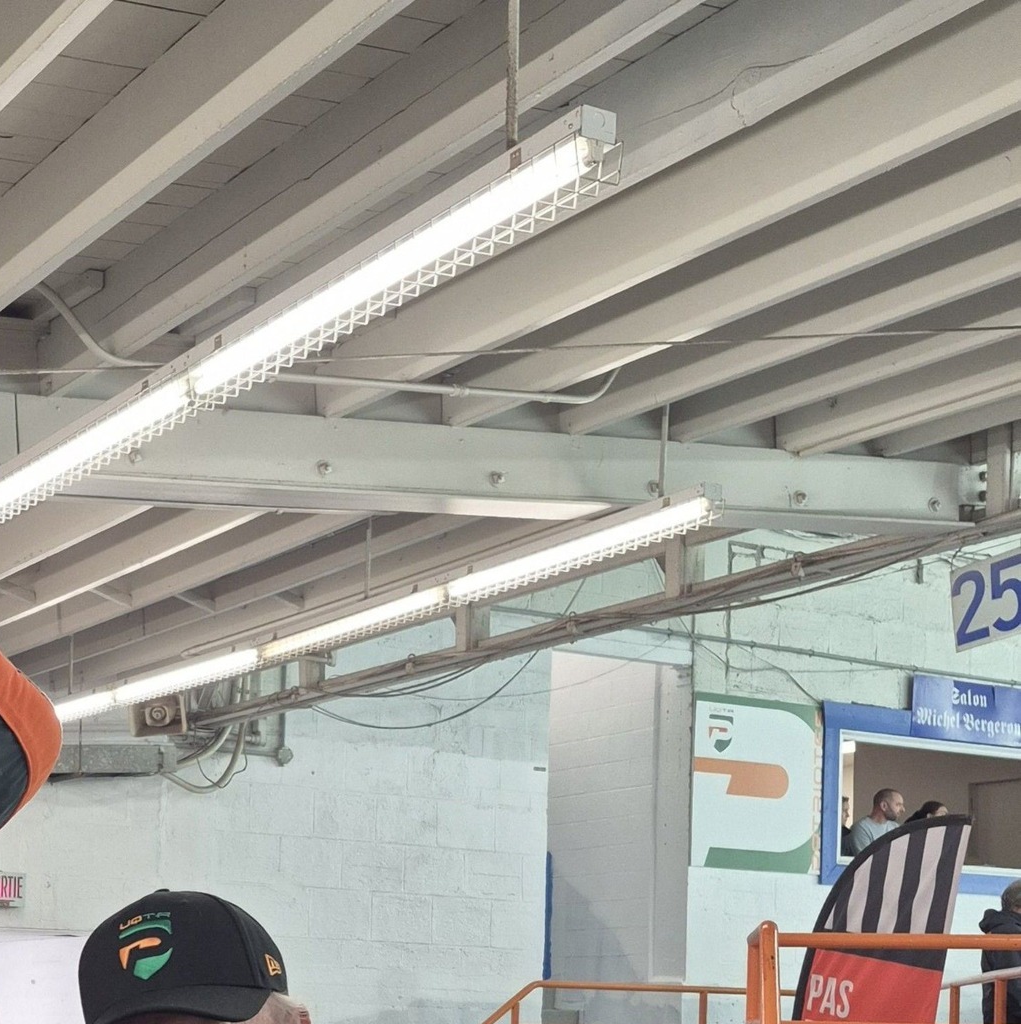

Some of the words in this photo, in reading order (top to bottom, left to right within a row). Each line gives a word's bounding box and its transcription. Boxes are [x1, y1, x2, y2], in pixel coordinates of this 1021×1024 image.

[952, 553, 1021, 647] 25
[952, 687, 988, 708] Salon
[916, 706, 961, 732] Michel
[963, 712, 1021, 738] Bergeron
[118, 911, 172, 930] UQTR
[806, 973, 854, 1019] PAS
